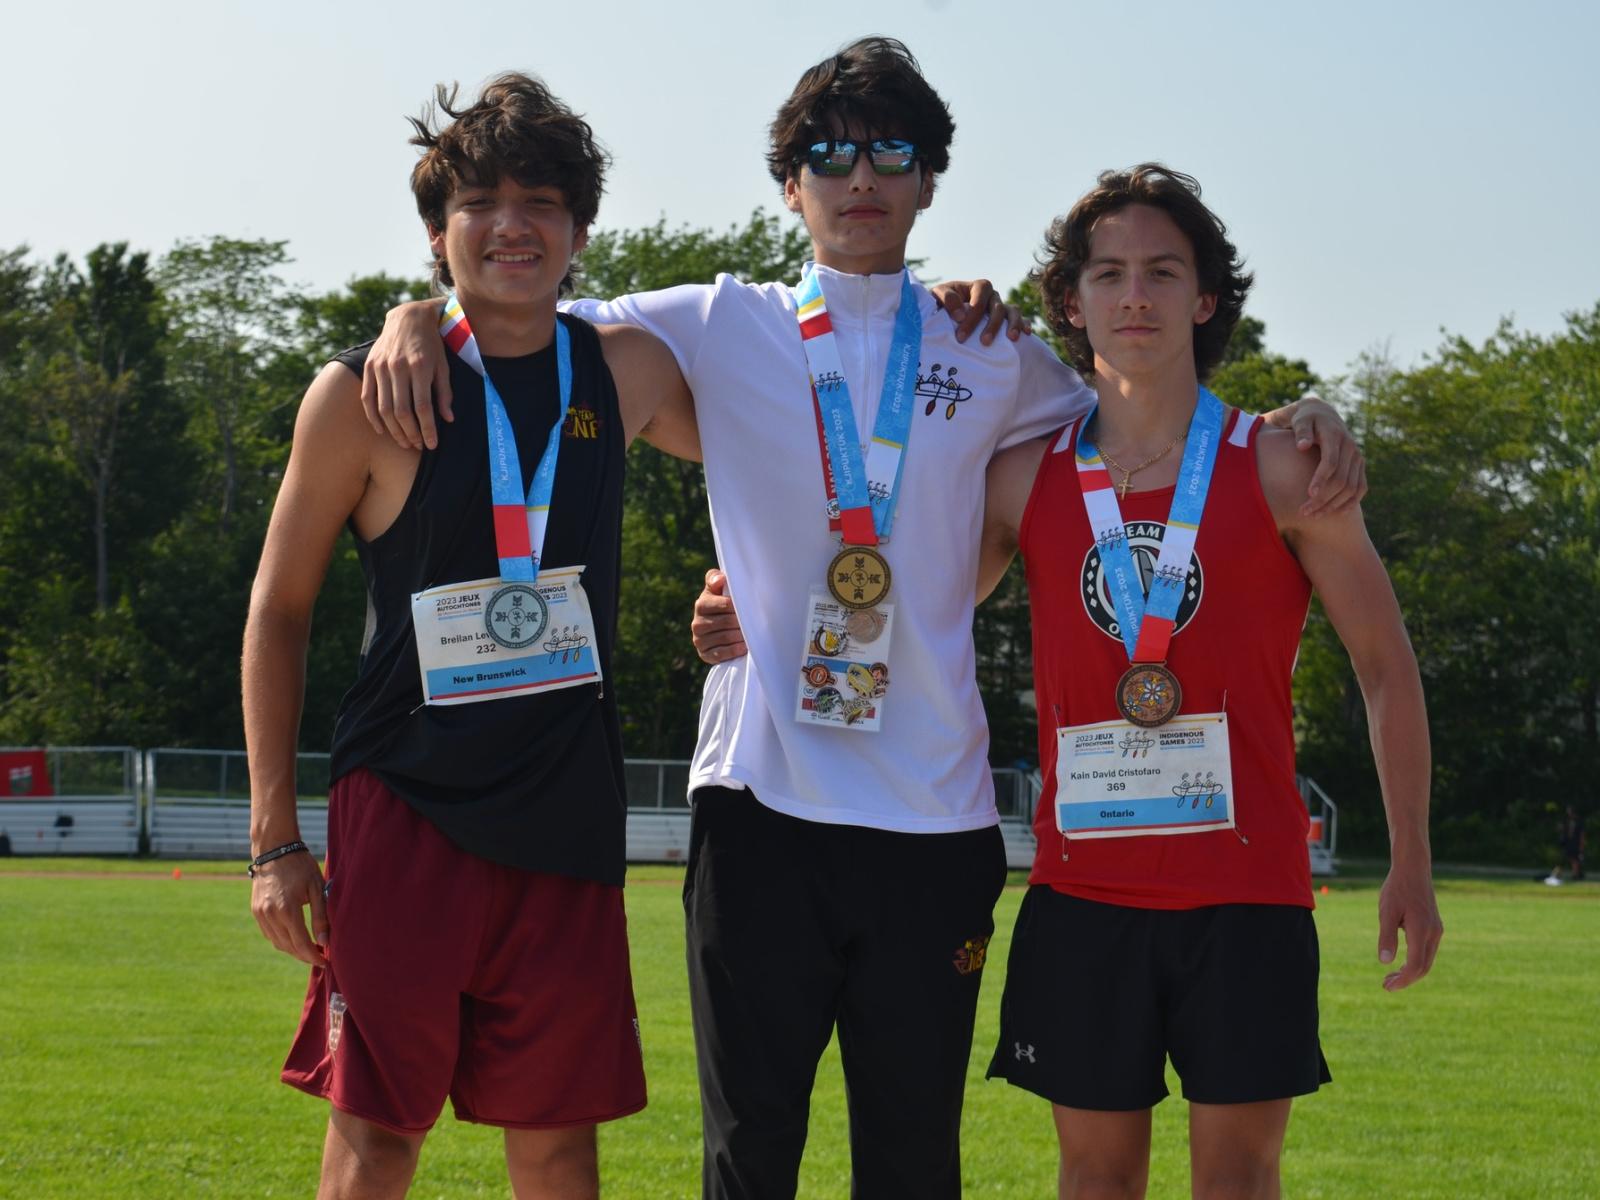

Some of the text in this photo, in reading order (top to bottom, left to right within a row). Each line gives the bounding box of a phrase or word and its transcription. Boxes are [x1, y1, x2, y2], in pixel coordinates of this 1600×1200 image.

[831, 408, 853, 486] KJIPUKTUK 2023
[496, 427, 509, 481] KJIPUKTUK
[1188, 472, 1200, 496] 2023
[1126, 524, 1160, 538] EAM
[537, 585, 567, 594] GENOUS
[436, 593, 480, 606] 2023 JEUX
[1114, 567, 1140, 637] JIPUKTUK 2023
[437, 601, 481, 612] AUTOCHTONES
[476, 643, 496, 654] 232
[453, 668, 527, 684] New Brunswick
[1076, 732, 1114, 743] 2023 JEUX
[1159, 731, 1204, 739] INDIGENOUS
[1075, 740, 1114, 748] AUTOCHTONES
[1070, 768, 1161, 780] Kain David Cristofaro
[1106, 782, 1126, 791] 369
[1100, 809, 1135, 818] Ontario
